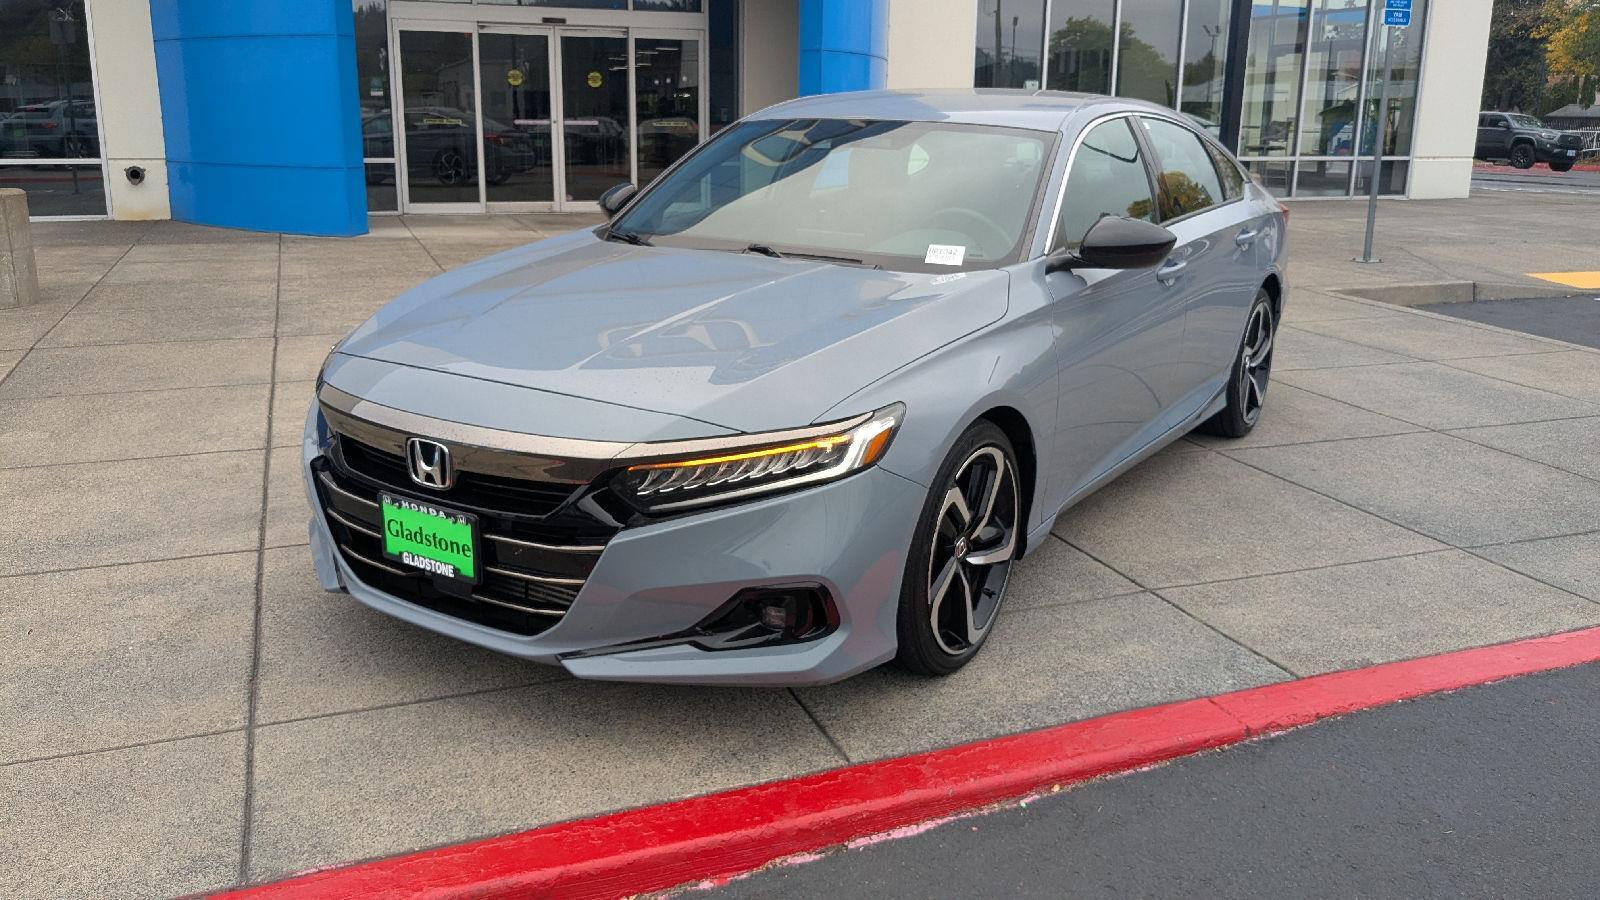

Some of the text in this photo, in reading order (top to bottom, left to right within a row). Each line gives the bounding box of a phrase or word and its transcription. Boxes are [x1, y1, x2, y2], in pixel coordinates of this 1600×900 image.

[401, 500, 446, 519] HONDA
[387, 518, 472, 558] Gladstone
[402, 551, 455, 578] GLADSTONE
